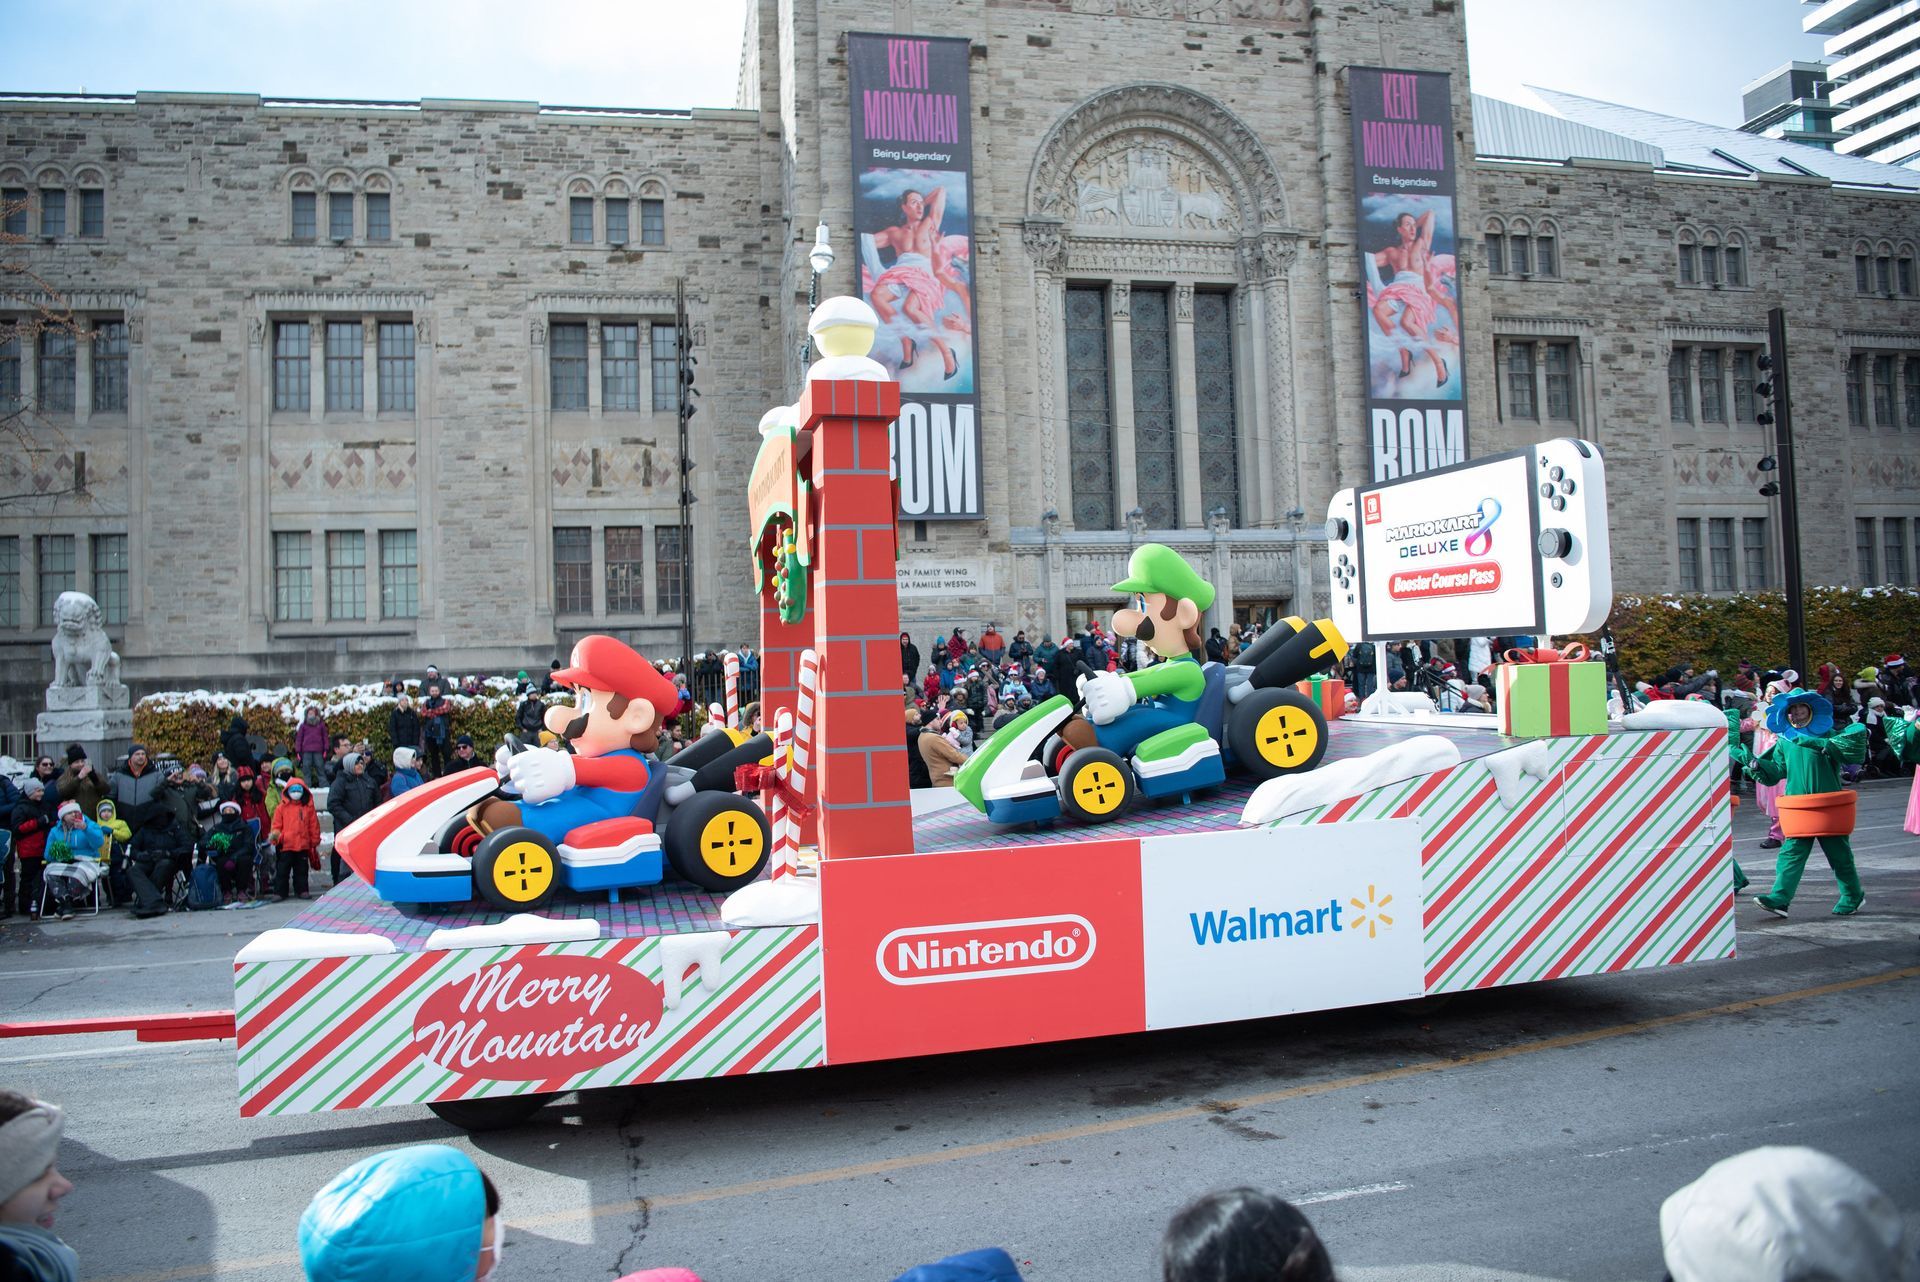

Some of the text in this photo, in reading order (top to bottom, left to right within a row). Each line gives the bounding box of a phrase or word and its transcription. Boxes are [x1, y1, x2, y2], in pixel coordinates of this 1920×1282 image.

[888, 39, 930, 89] KENT
[864, 90, 958, 144] MONKMAN
[1382, 73, 1418, 120] KENT
[873, 148, 951, 163] Being Legendary
[1362, 121, 1444, 171] MONKMAN
[1372, 174, 1438, 188] Être légendaire
[889, 402, 978, 515] OM
[1371, 408, 1465, 482] ROM
[1400, 539, 1459, 558] DELUXE
[1465, 497, 1502, 557] 8
[944, 568, 968, 576] WING
[944, 580, 976, 588] WESTON
[1393, 568, 1495, 593] Booster Course Pass
[1190, 899, 1342, 945] Walmart
[451, 962, 612, 1016] Merry
[415, 1013, 652, 1069] Mountain
